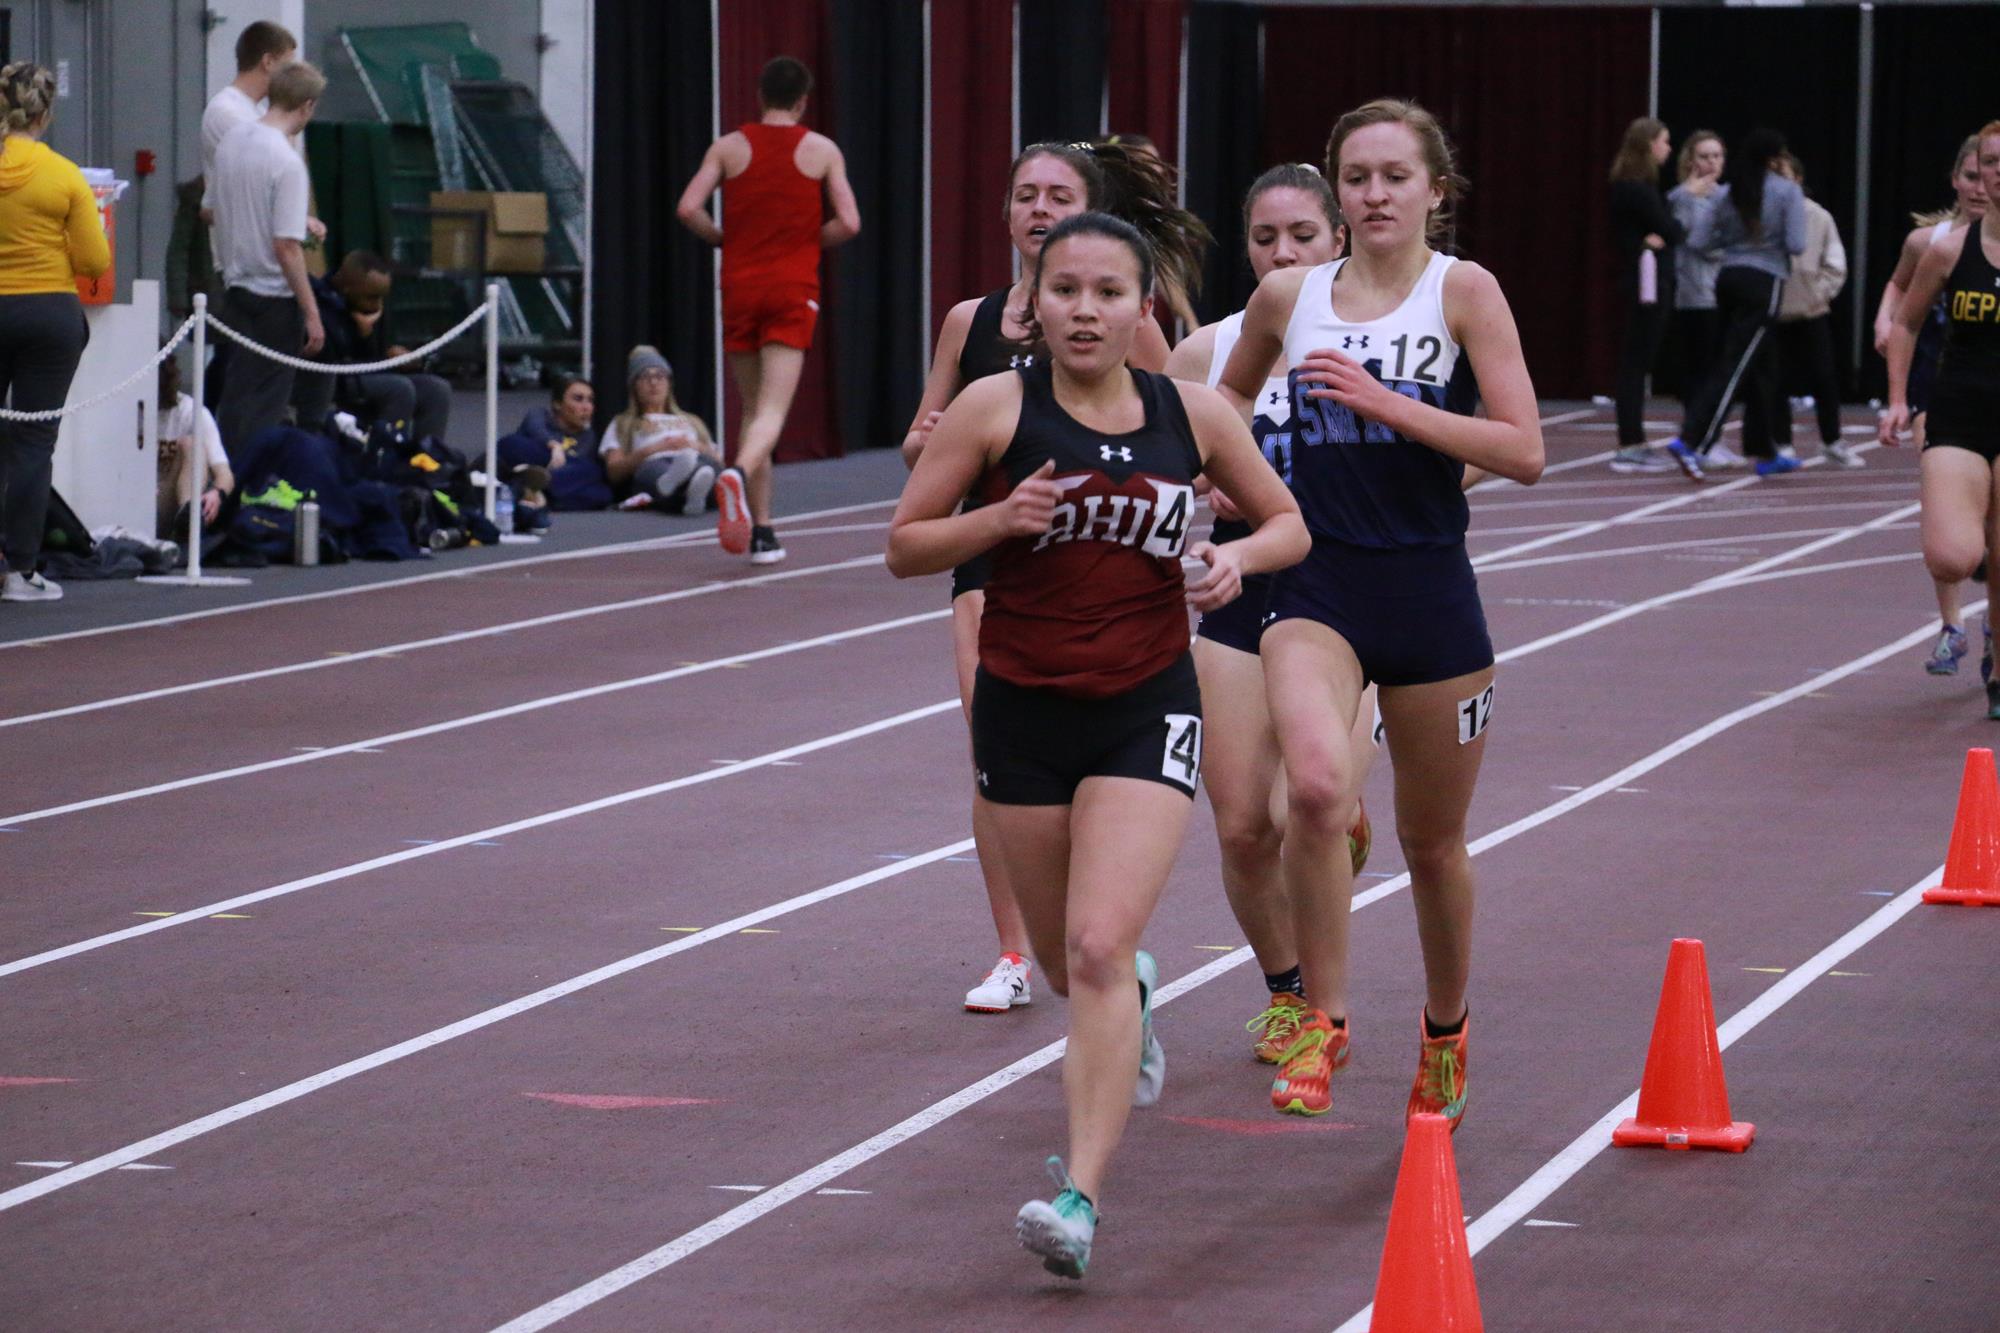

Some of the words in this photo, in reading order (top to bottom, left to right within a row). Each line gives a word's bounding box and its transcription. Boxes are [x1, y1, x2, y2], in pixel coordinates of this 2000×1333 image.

[1390, 333, 1442, 382] 12
[1154, 491, 1187, 552] 4
[1463, 685, 1493, 739] 12
[1169, 720, 1197, 780] 4
